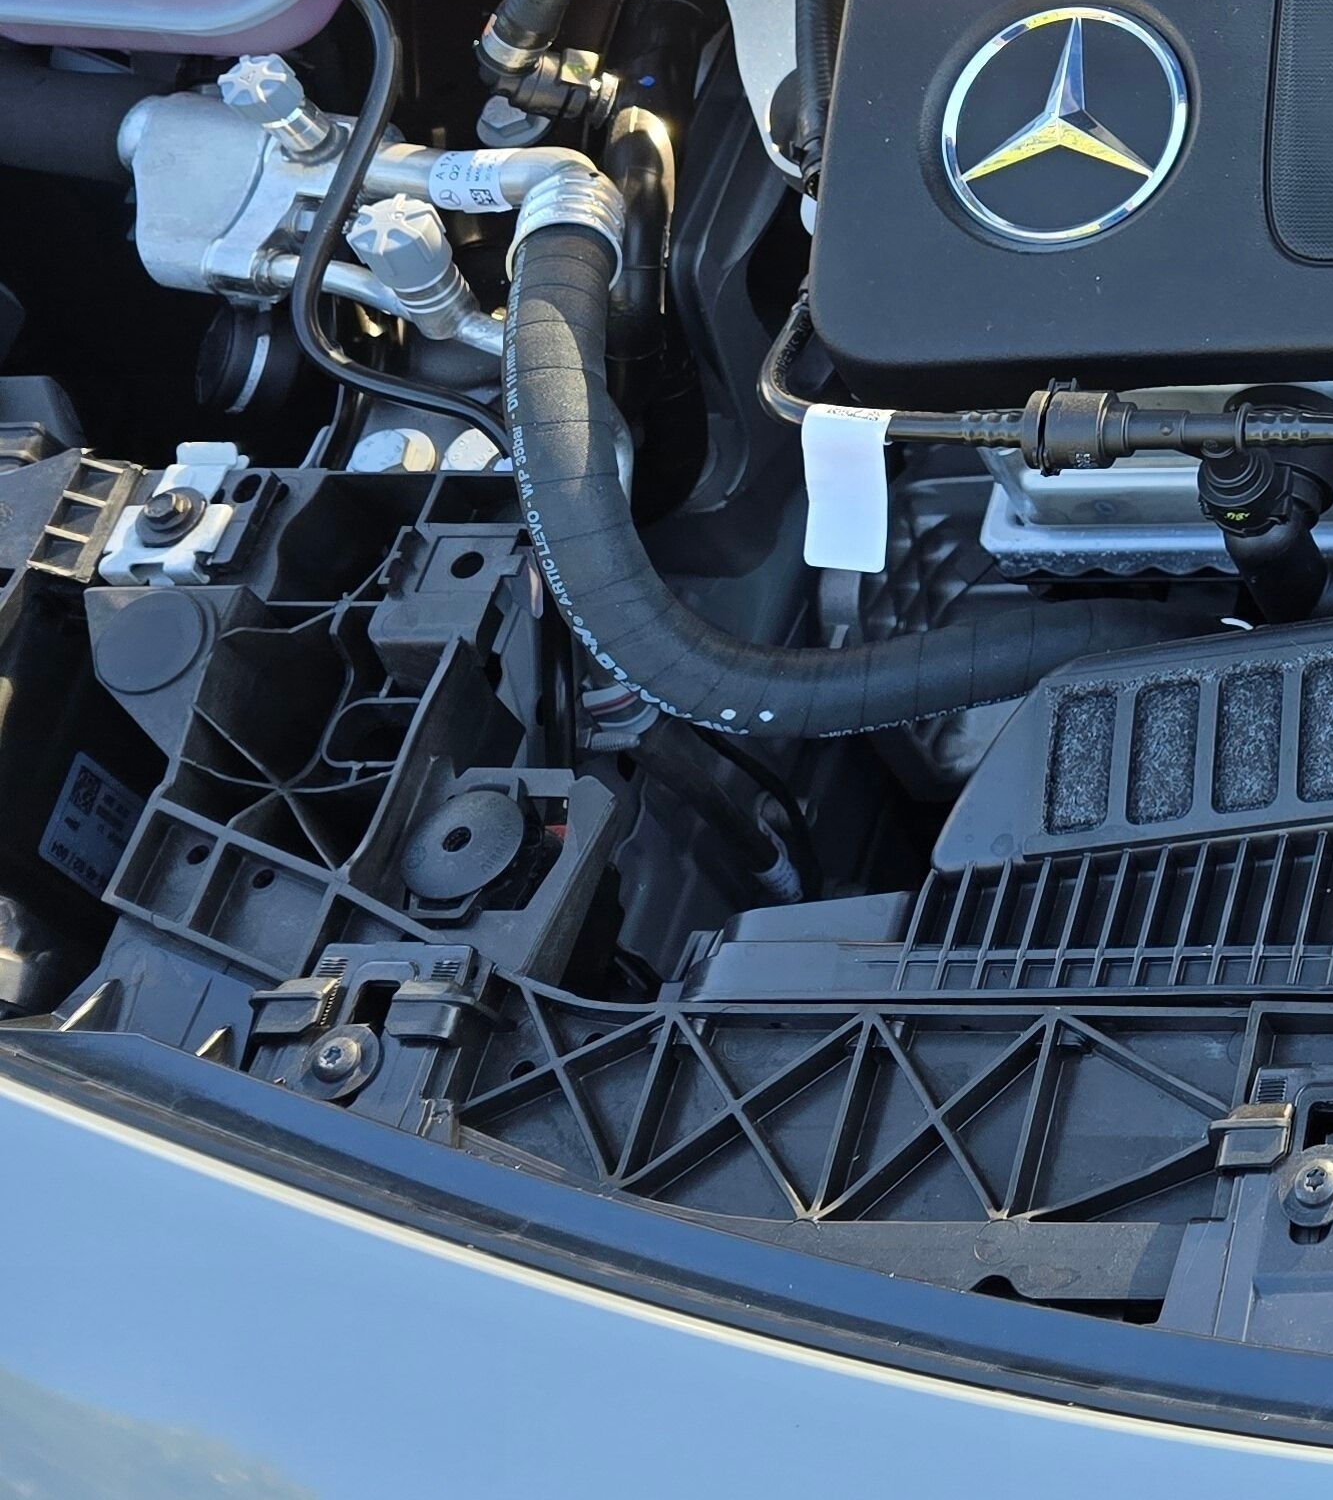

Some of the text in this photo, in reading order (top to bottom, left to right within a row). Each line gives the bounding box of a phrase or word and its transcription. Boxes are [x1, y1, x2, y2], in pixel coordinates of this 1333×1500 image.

[512, 425, 527, 467] 35bar
[527, 510, 551, 557] LEVO
[541, 558, 573, 606] ARTIC
